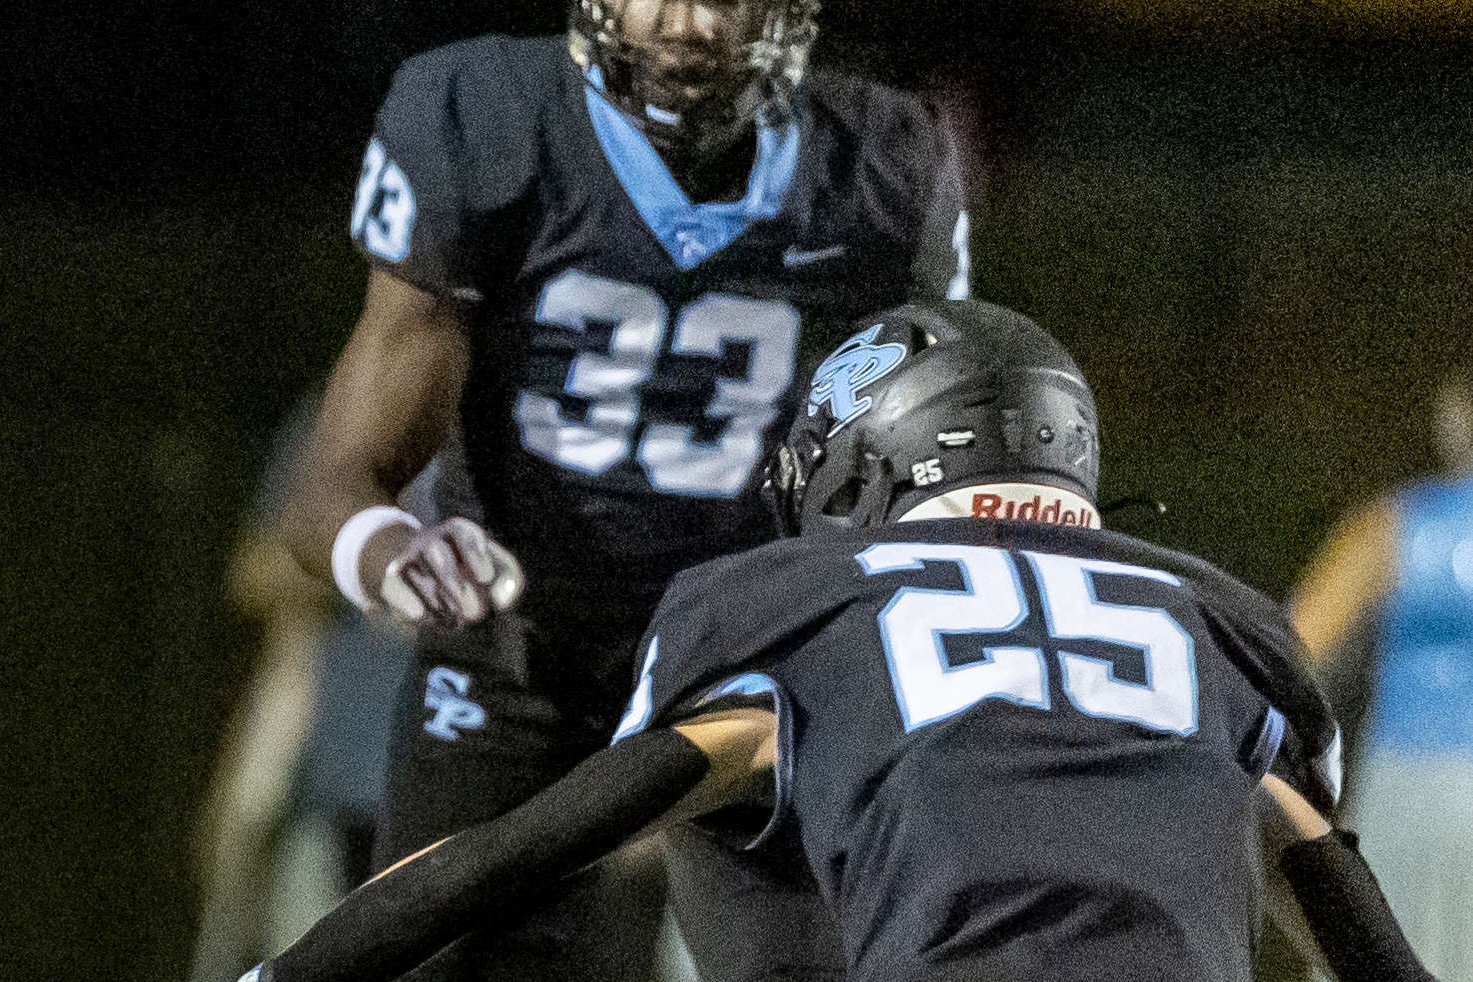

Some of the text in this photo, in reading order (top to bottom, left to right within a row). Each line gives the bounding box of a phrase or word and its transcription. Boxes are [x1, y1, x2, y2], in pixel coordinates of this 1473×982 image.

[517, 267, 801, 498] 33
[911, 458, 944, 487] 25
[854, 541, 1198, 736] 25
